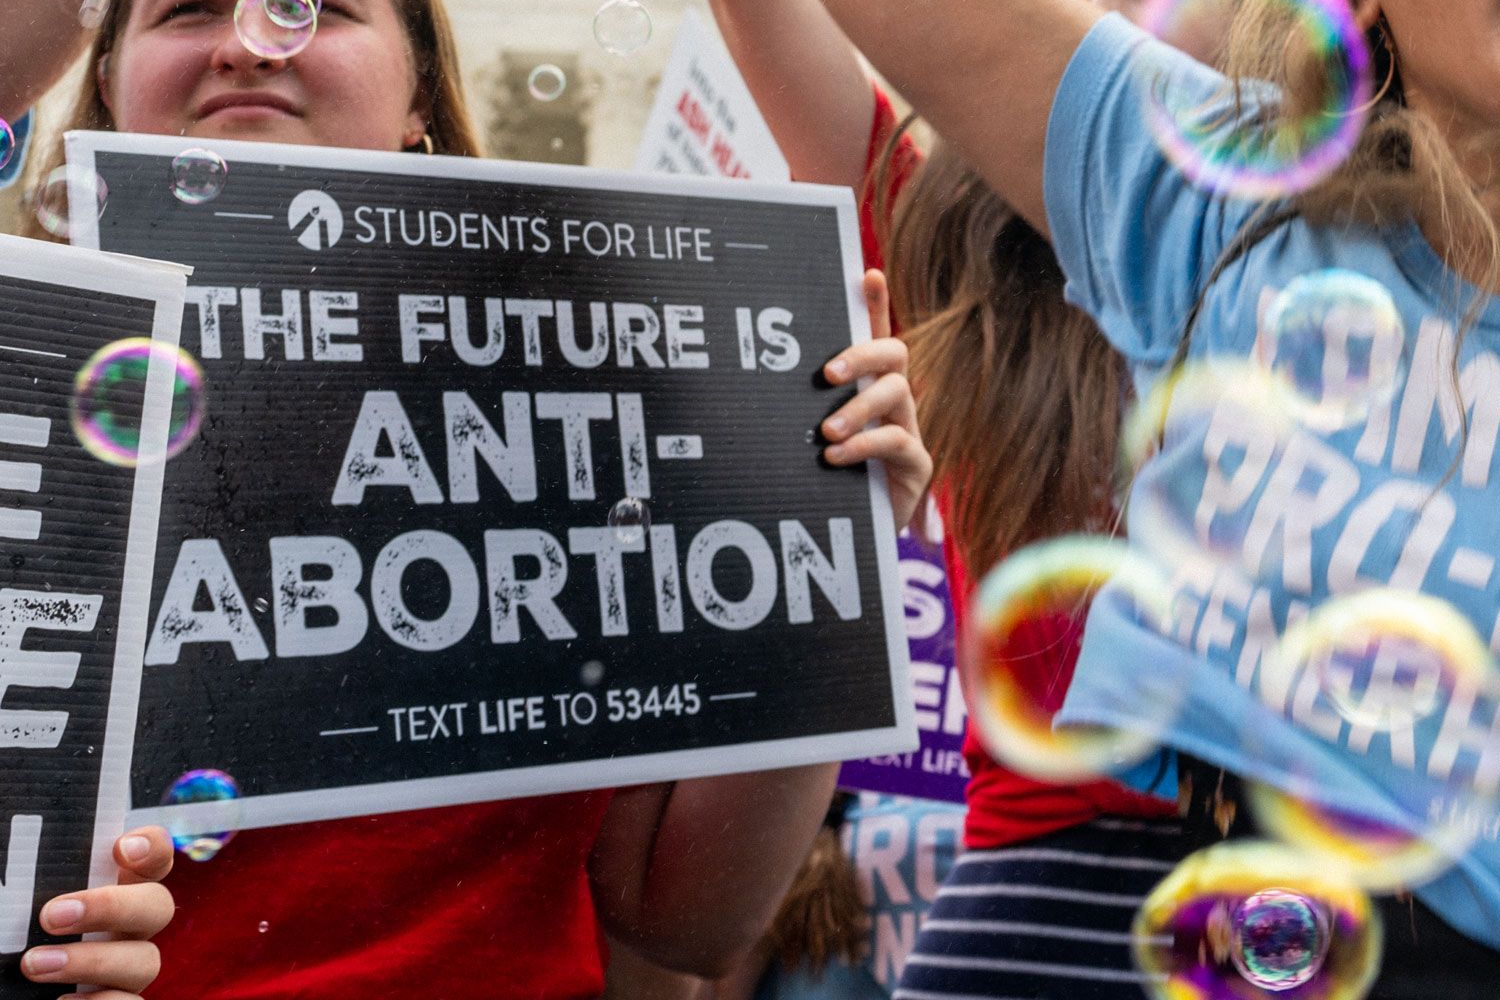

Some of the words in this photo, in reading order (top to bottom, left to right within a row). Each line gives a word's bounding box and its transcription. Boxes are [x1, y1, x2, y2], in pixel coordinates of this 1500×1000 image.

[354, 205, 550, 254] STUDENTS
[562, 219, 636, 256] FOR
[648, 227, 715, 262] LIFE
[190, 286, 364, 362] THE
[398, 295, 710, 370] FUTURE
[736, 306, 801, 372] IS
[330, 390, 705, 507] ANTI-
[145, 517, 863, 667] ABORTION
[387, 703, 468, 742] TEXT
[479, 696, 546, 735] LIFE
[553, 692, 597, 726] TO
[606, 683, 702, 723] 53445
